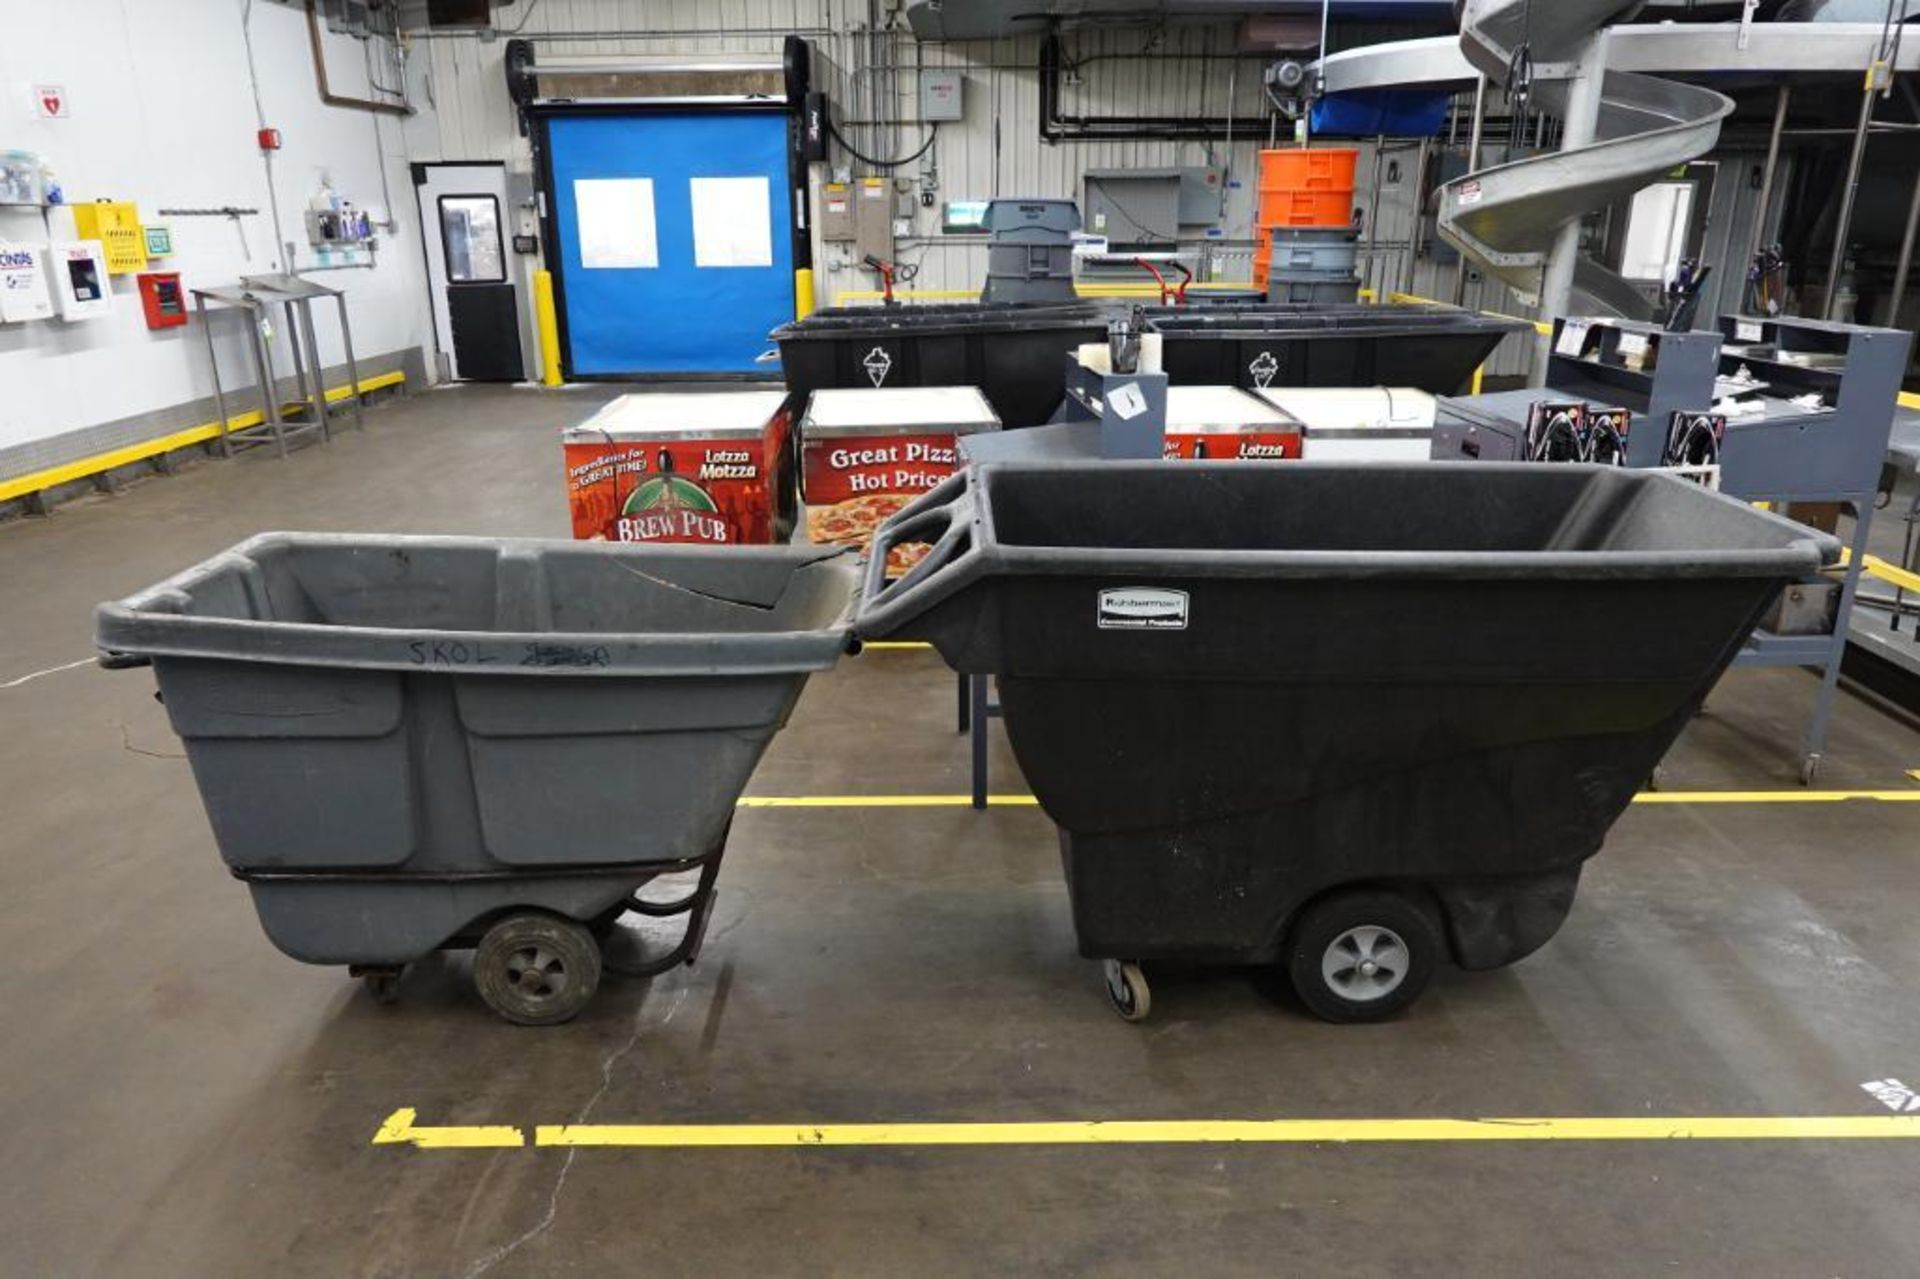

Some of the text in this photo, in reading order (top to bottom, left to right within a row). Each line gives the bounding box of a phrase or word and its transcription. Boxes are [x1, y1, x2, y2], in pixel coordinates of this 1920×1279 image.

[628, 449, 645, 460] for
[706, 449, 749, 464] Lotzza
[830, 443, 956, 468] Great Pizz
[1240, 443, 1283, 457] Lotzza
[580, 466, 613, 485] GREAT
[700, 464, 756, 479] Motzza
[849, 473, 889, 491] Hot
[618, 510, 726, 542] BREW PUB
[409, 640, 500, 664] SKOL
